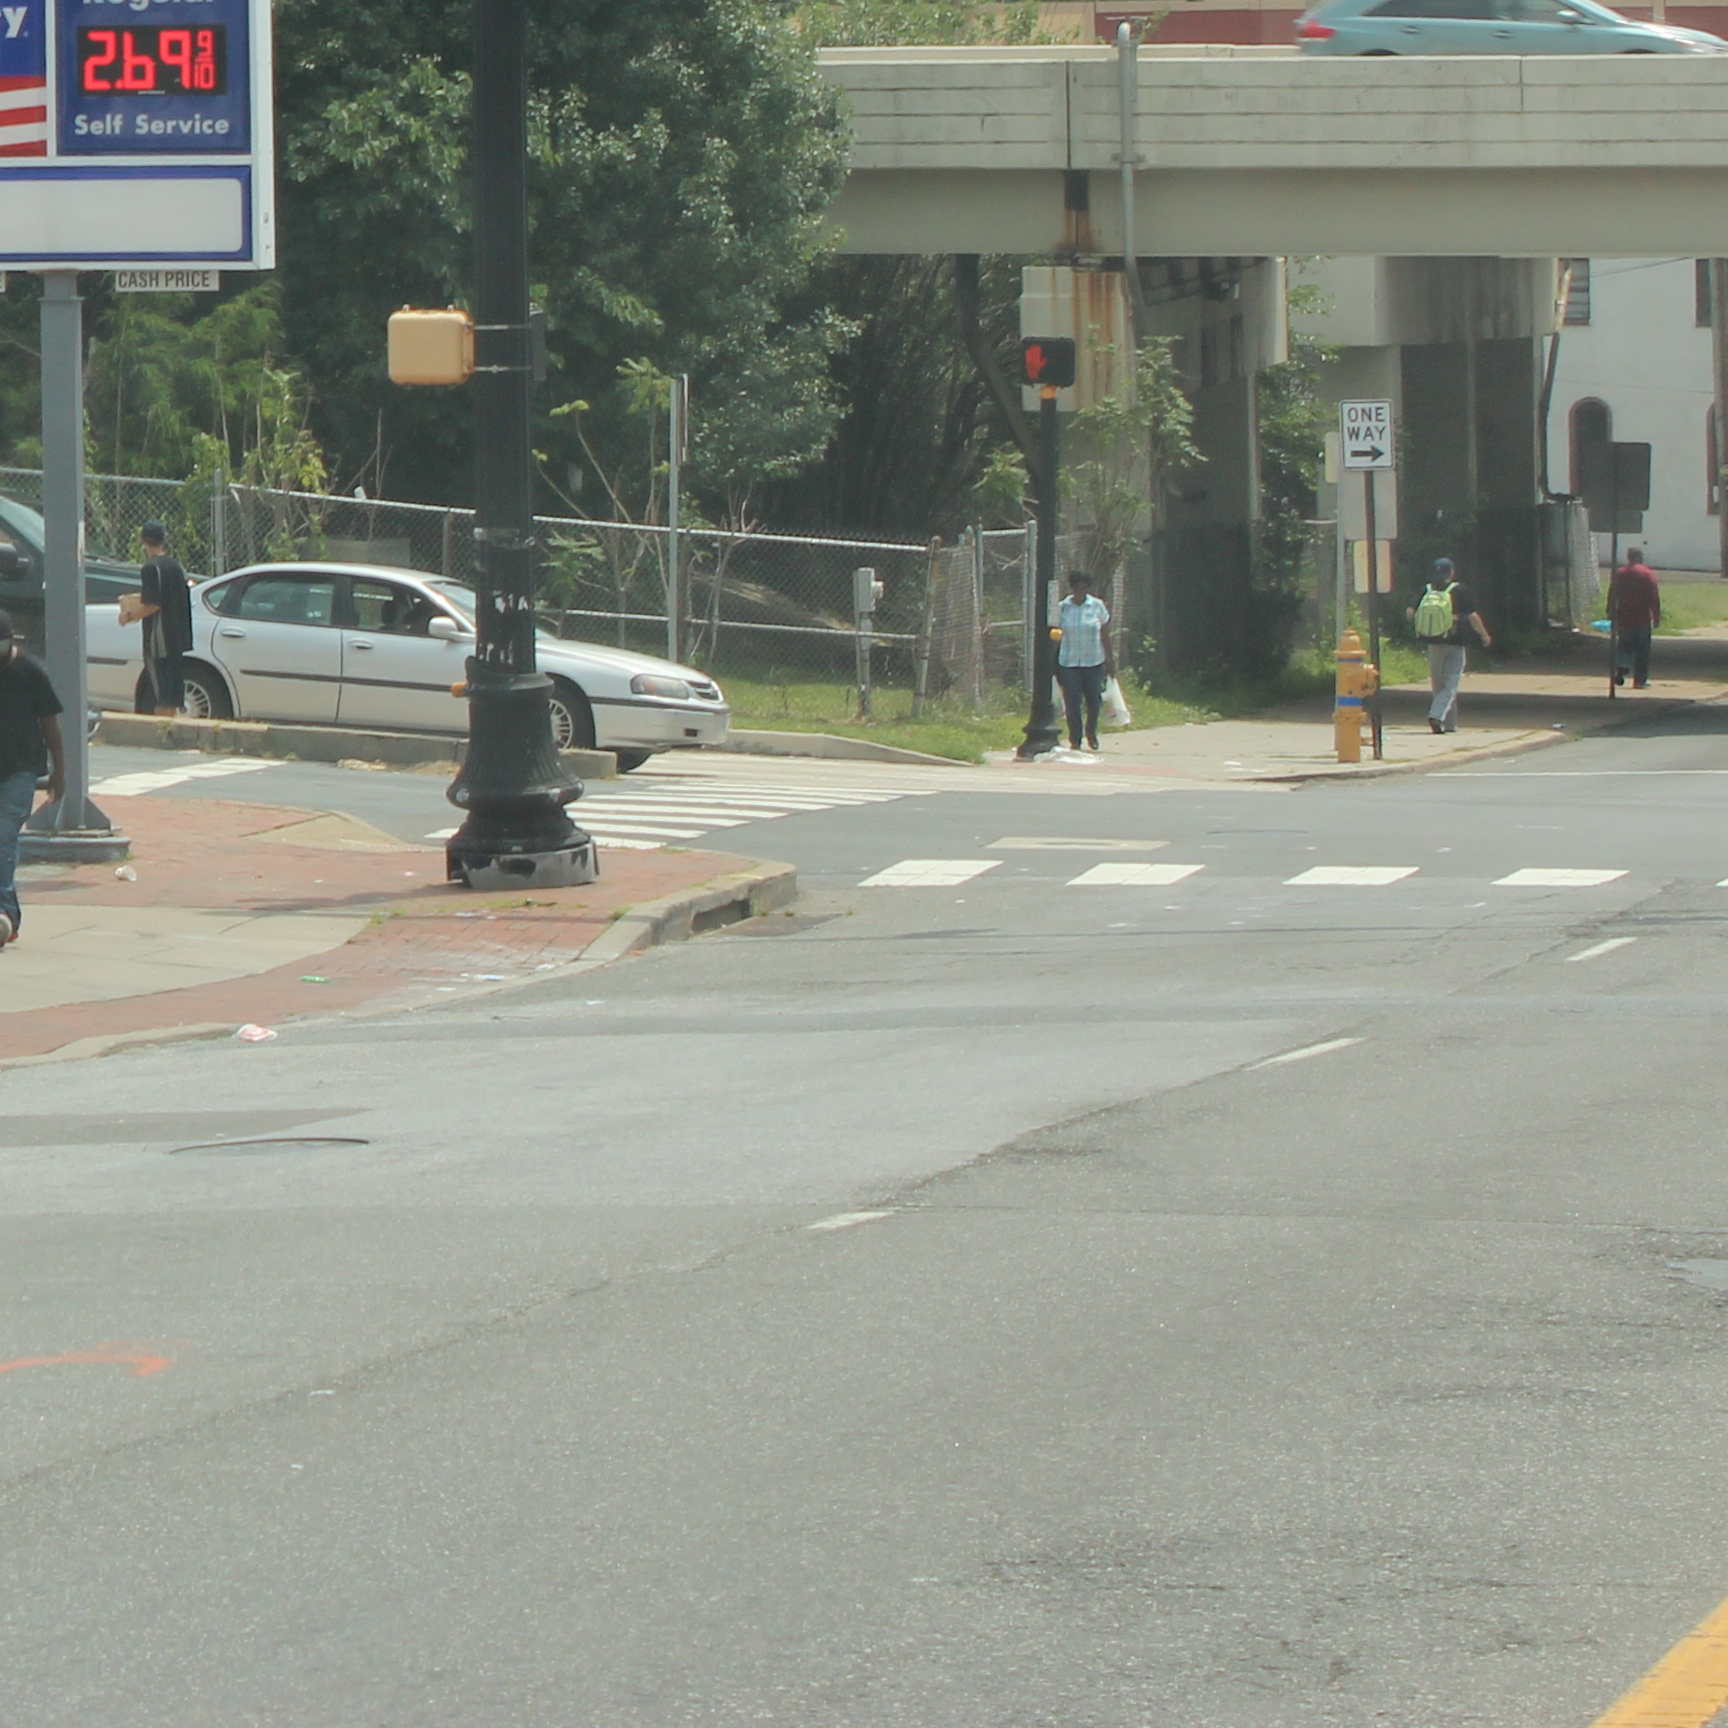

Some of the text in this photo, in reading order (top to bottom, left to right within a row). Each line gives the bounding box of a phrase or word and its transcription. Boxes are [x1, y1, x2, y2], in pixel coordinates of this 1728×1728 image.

[83, 29, 193, 90] 2.69
[74, 113, 231, 136] Self Service
[118, 270, 211, 288] CASH PRICE
[1347, 406, 1386, 423] ONE
[1347, 425, 1387, 442] WAY
